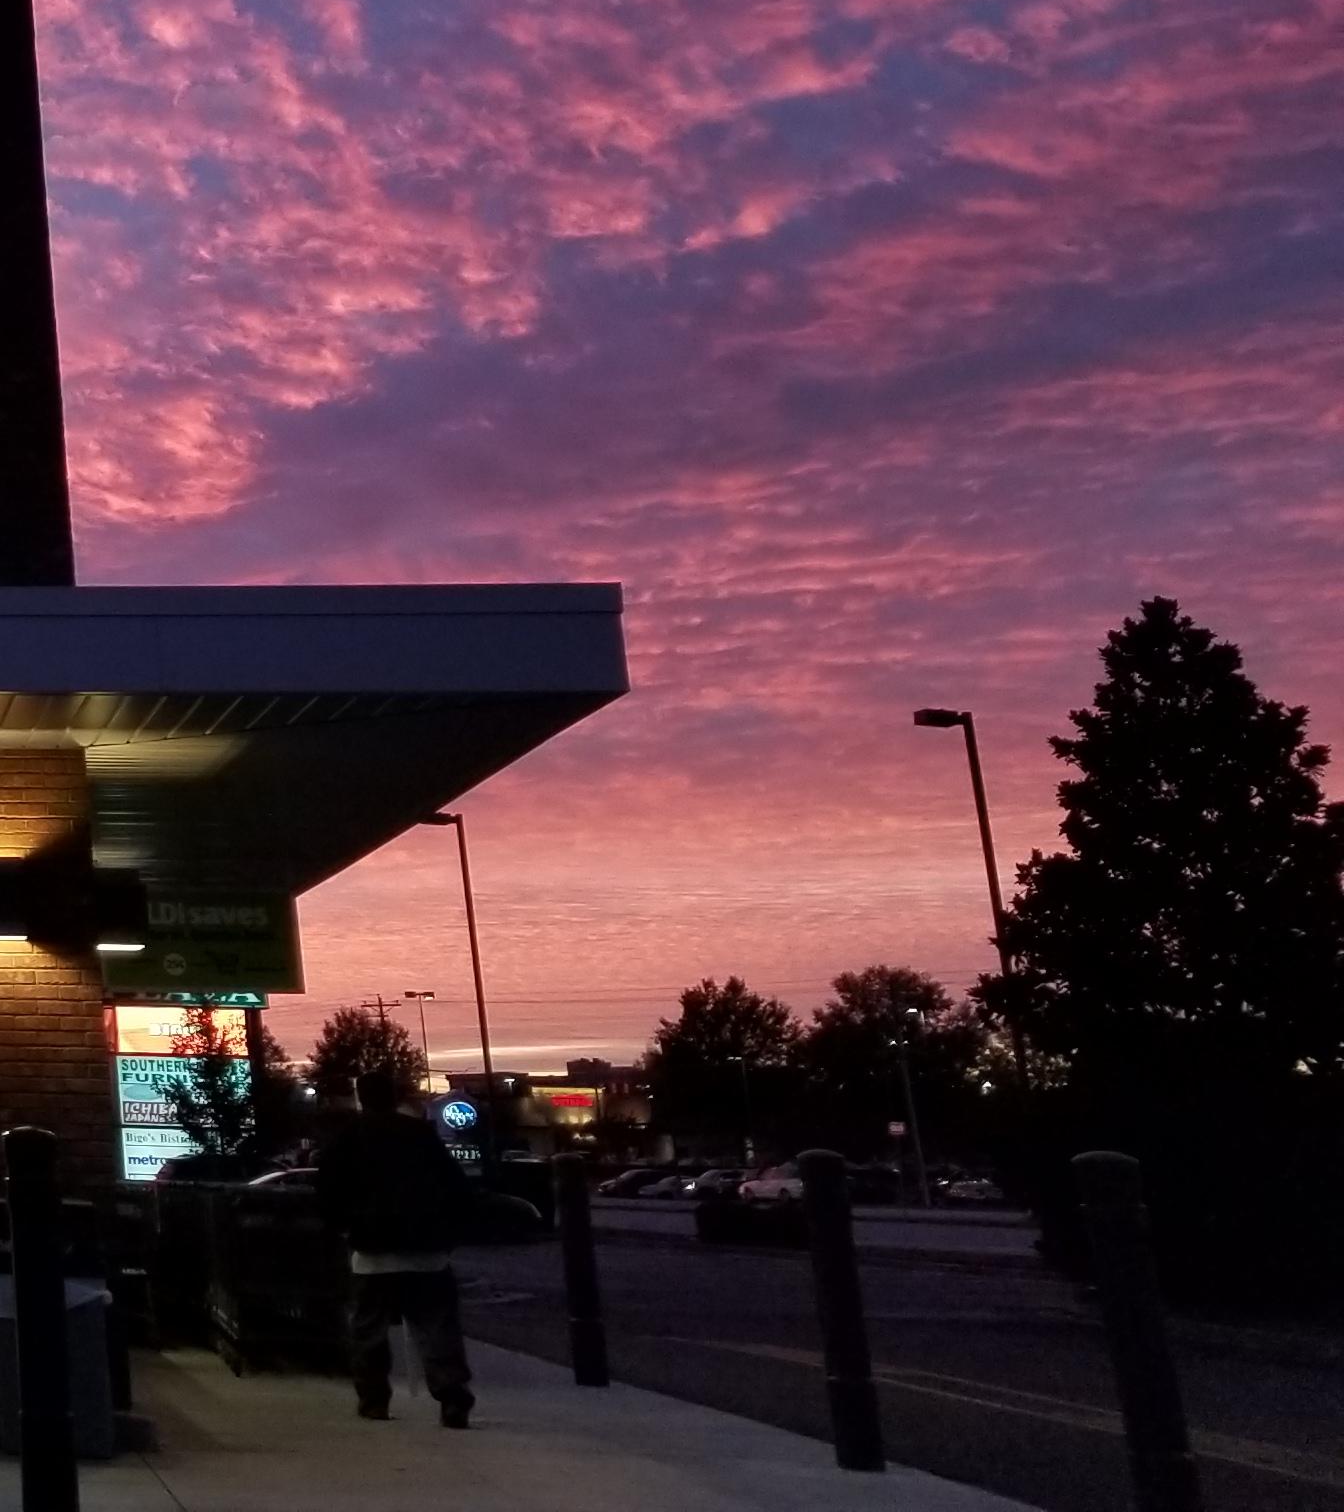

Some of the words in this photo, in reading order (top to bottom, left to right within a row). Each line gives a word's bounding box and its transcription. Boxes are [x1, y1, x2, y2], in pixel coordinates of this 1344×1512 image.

[147, 902, 185, 925] LDI
[190, 906, 270, 926] saves
[124, 1102, 178, 1114] ICHIBA
